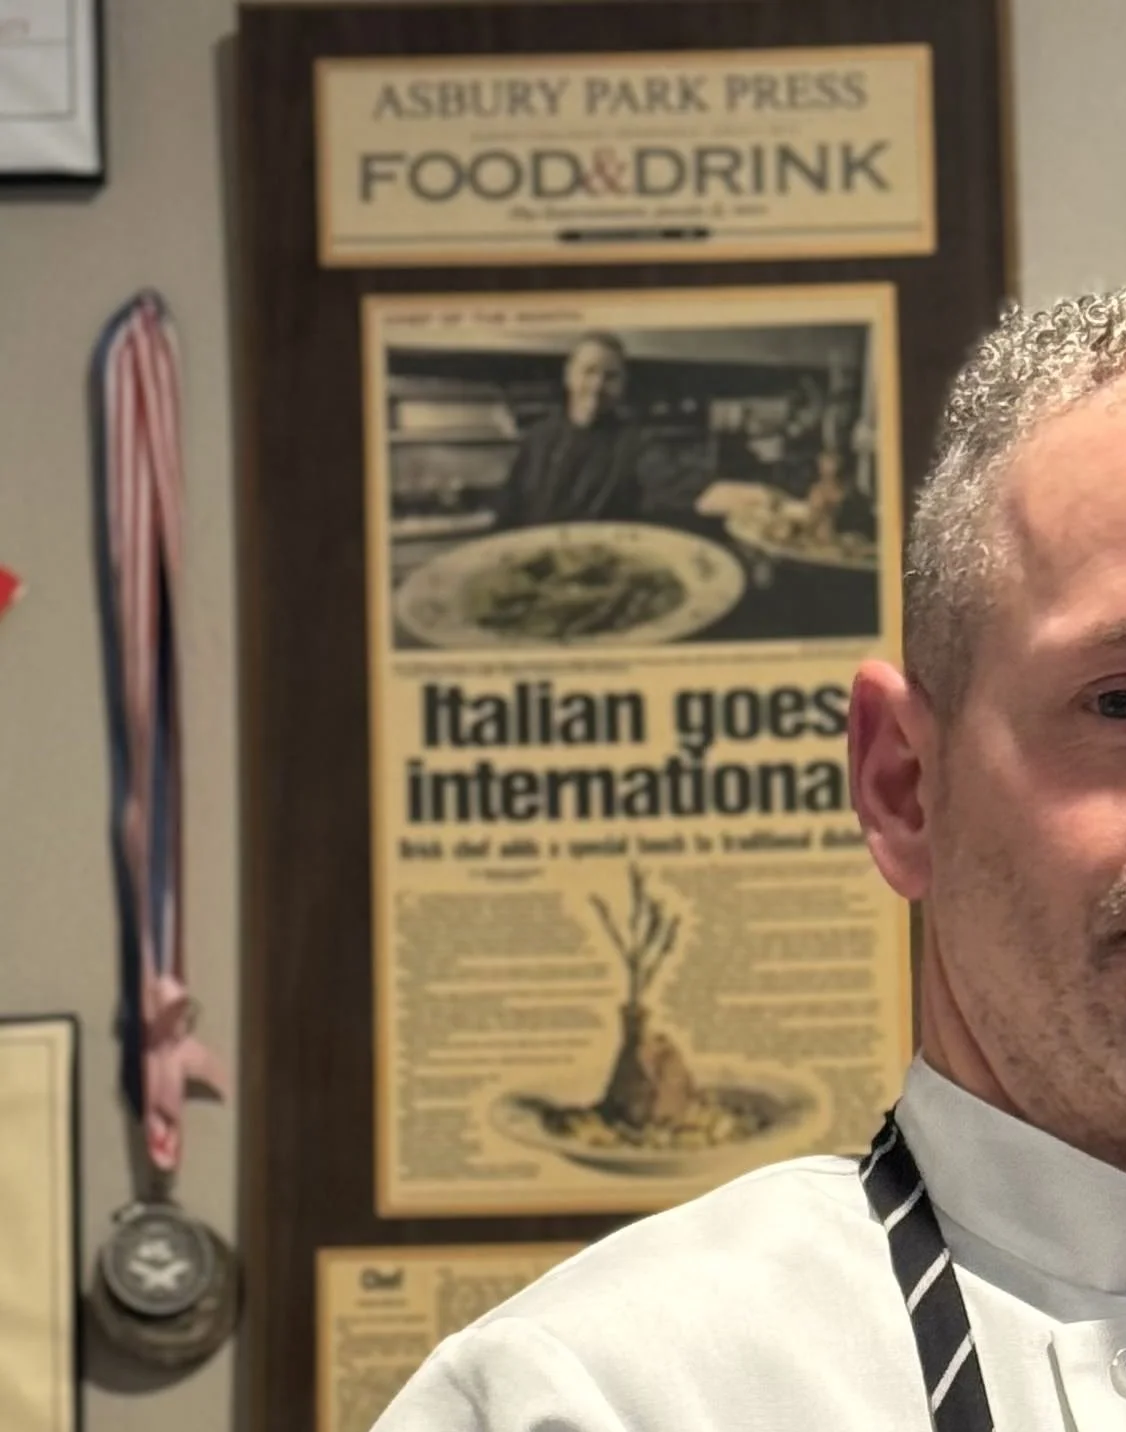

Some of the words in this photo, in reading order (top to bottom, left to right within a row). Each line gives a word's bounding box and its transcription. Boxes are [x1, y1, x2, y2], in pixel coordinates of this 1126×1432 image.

[372, 77, 571, 121] ASBURY
[583, 74, 712, 115] PARK
[724, 69, 869, 112] PRESS
[422, 681, 648, 749] Italian
[673, 684, 850, 763] goes
[407, 754, 847, 824] internationa
